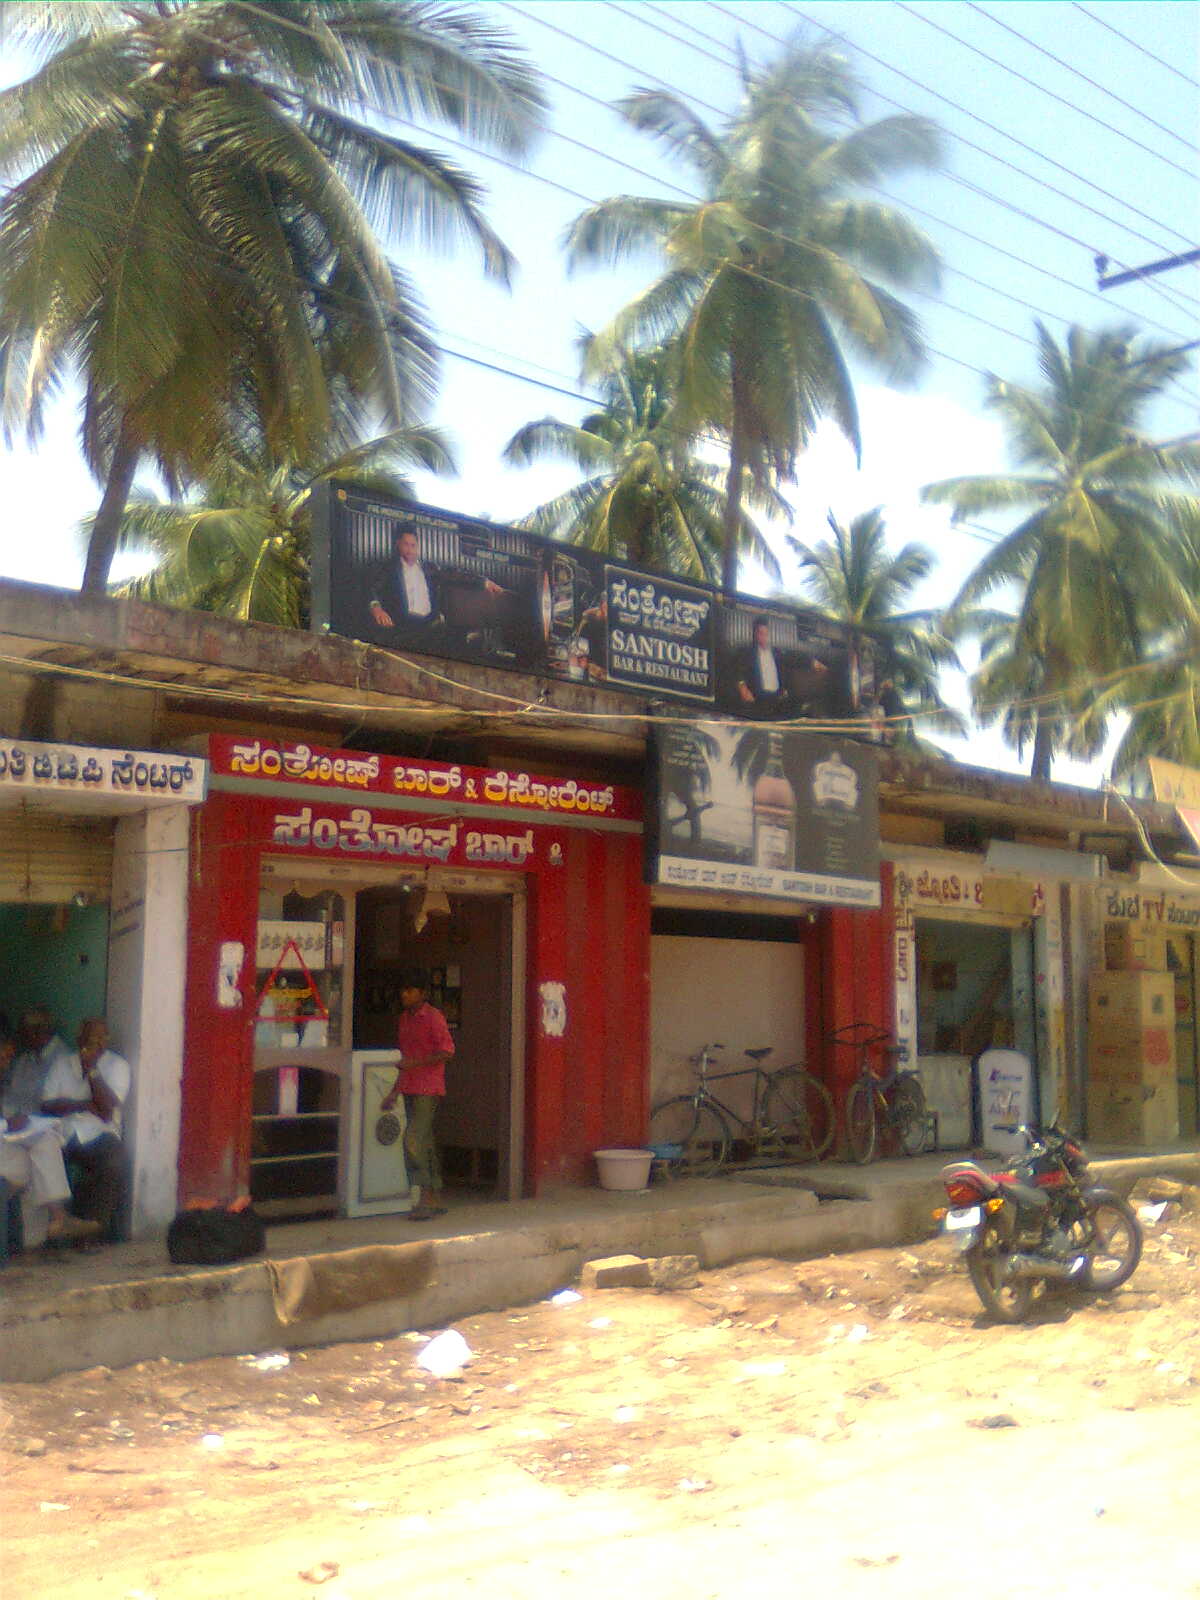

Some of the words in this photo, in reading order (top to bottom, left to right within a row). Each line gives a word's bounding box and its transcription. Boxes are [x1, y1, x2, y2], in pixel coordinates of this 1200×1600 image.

[611, 629, 708, 671] SANTOSH
[393, 766, 462, 794] ಬಾರ್
[464, 778, 478, 799] &
[464, 829, 534, 864] ಬಾರ್
[549, 842, 564, 866] &
